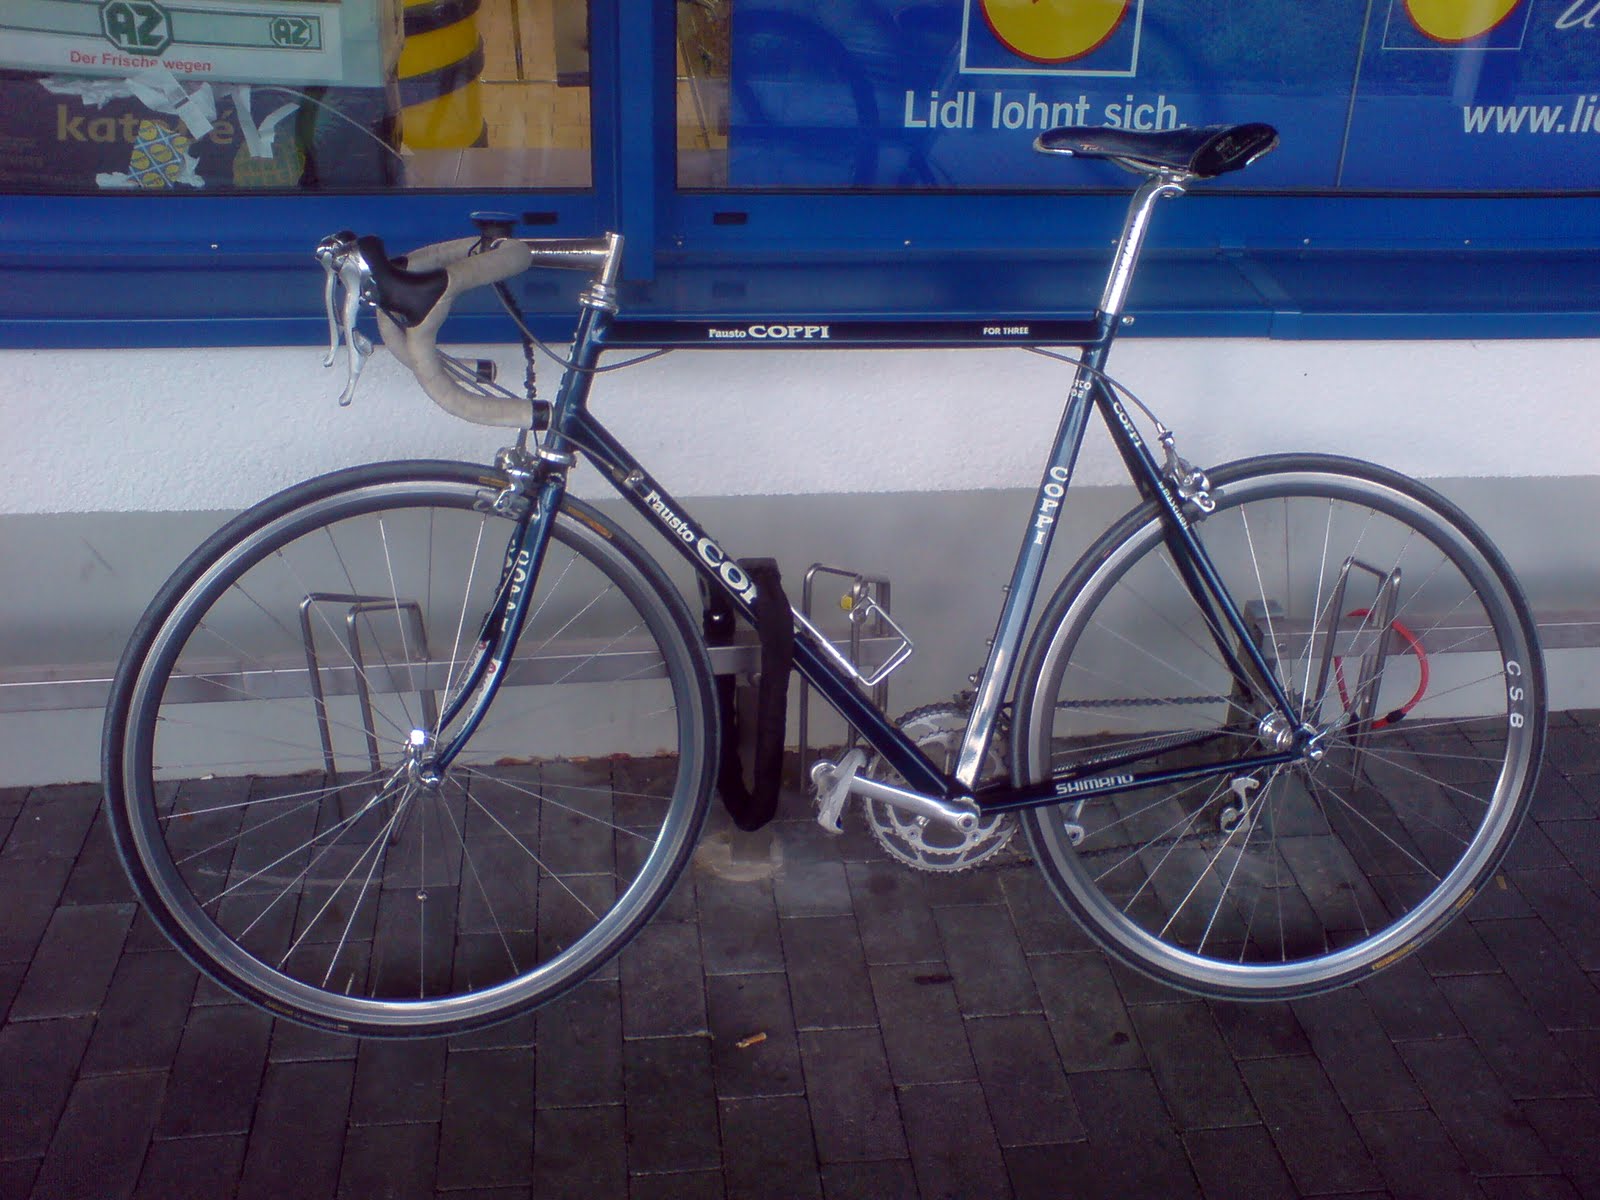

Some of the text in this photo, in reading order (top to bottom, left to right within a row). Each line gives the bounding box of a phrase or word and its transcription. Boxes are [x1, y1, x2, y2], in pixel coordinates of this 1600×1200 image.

[106, 3, 167, 47] AZ
[277, 19, 309, 46] AZ
[70, 50, 212, 73] Der Frische wegen
[904, 90, 1188, 131] Lidl lohnt sich.
[1463, 95, 1600, 133] www.li
[708, 325, 830, 339] Fausto COPPI
[983, 326, 1029, 335] FOR THREE
[643, 489, 695, 542] Fausto
[1033, 466, 1068, 545] COPPI
[1055, 773, 1135, 795] SHIMANO
